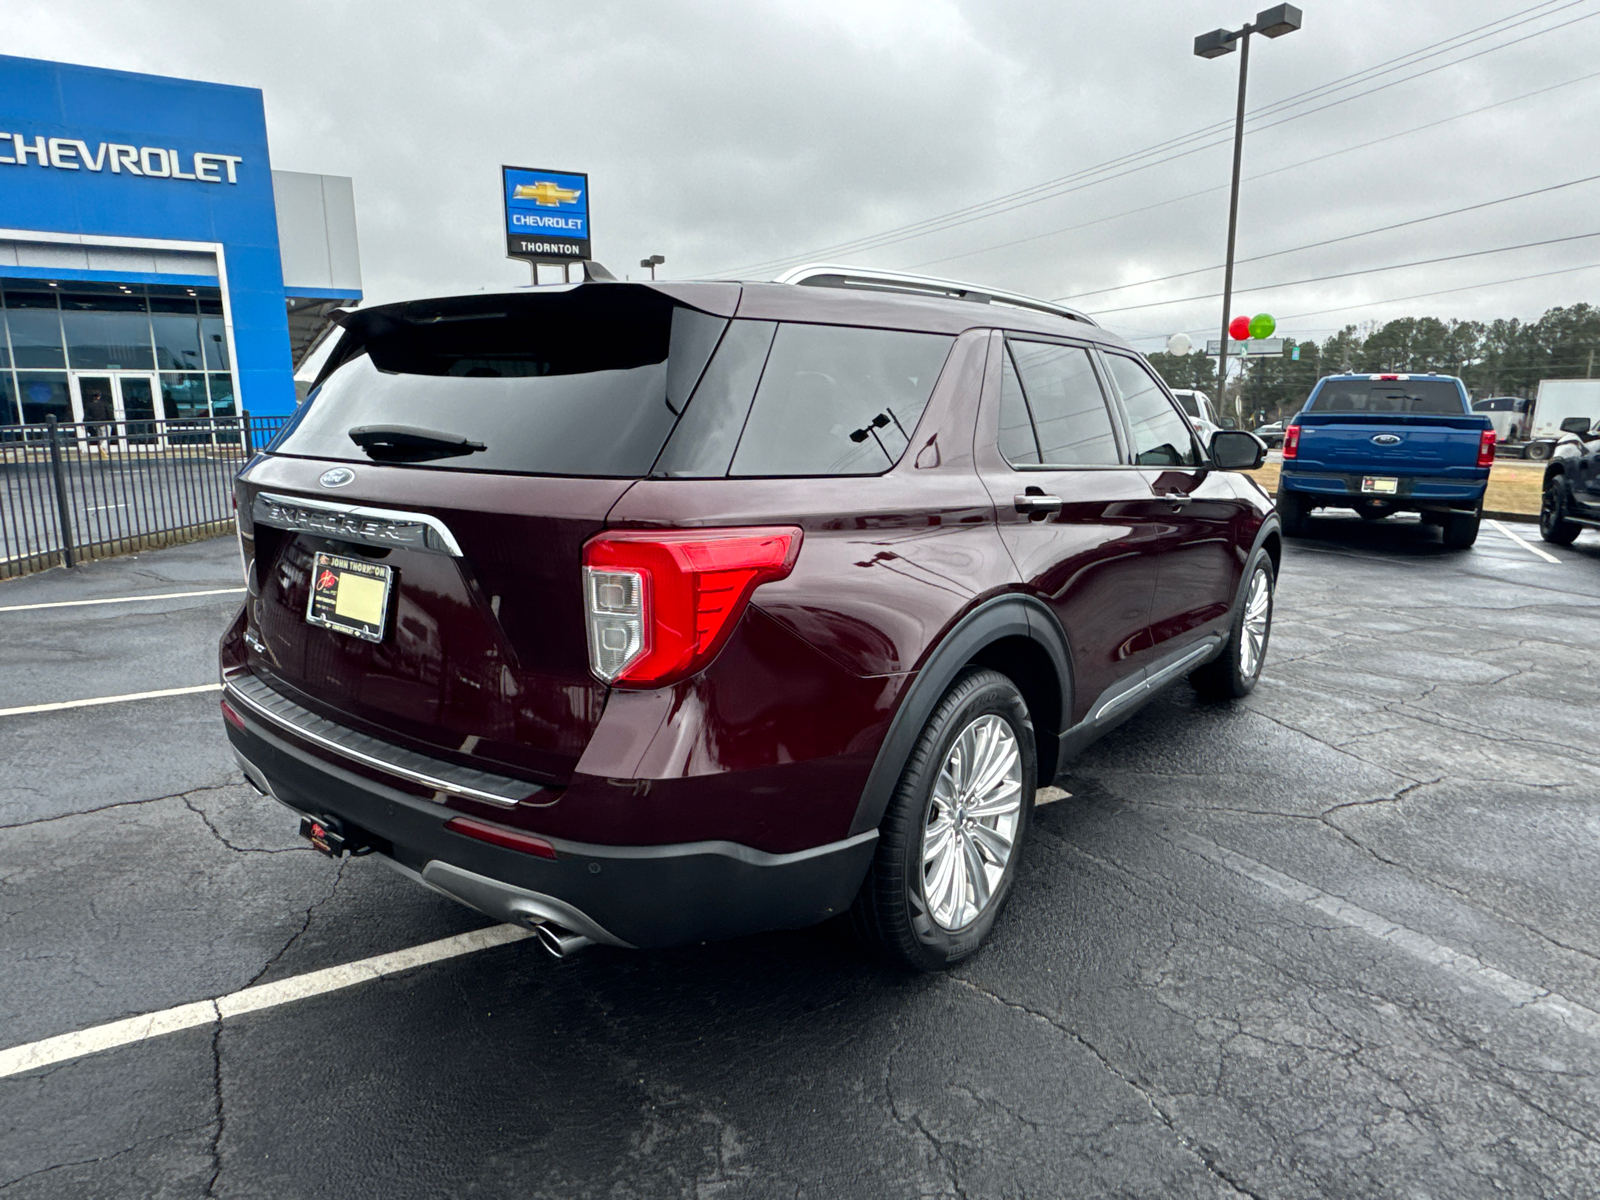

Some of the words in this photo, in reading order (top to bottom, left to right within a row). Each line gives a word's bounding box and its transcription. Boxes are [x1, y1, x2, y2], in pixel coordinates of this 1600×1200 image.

[512, 214, 583, 230] CHEVROLET
[520, 241, 579, 254] THORNTON
[330, 557, 349, 570] JOHN
